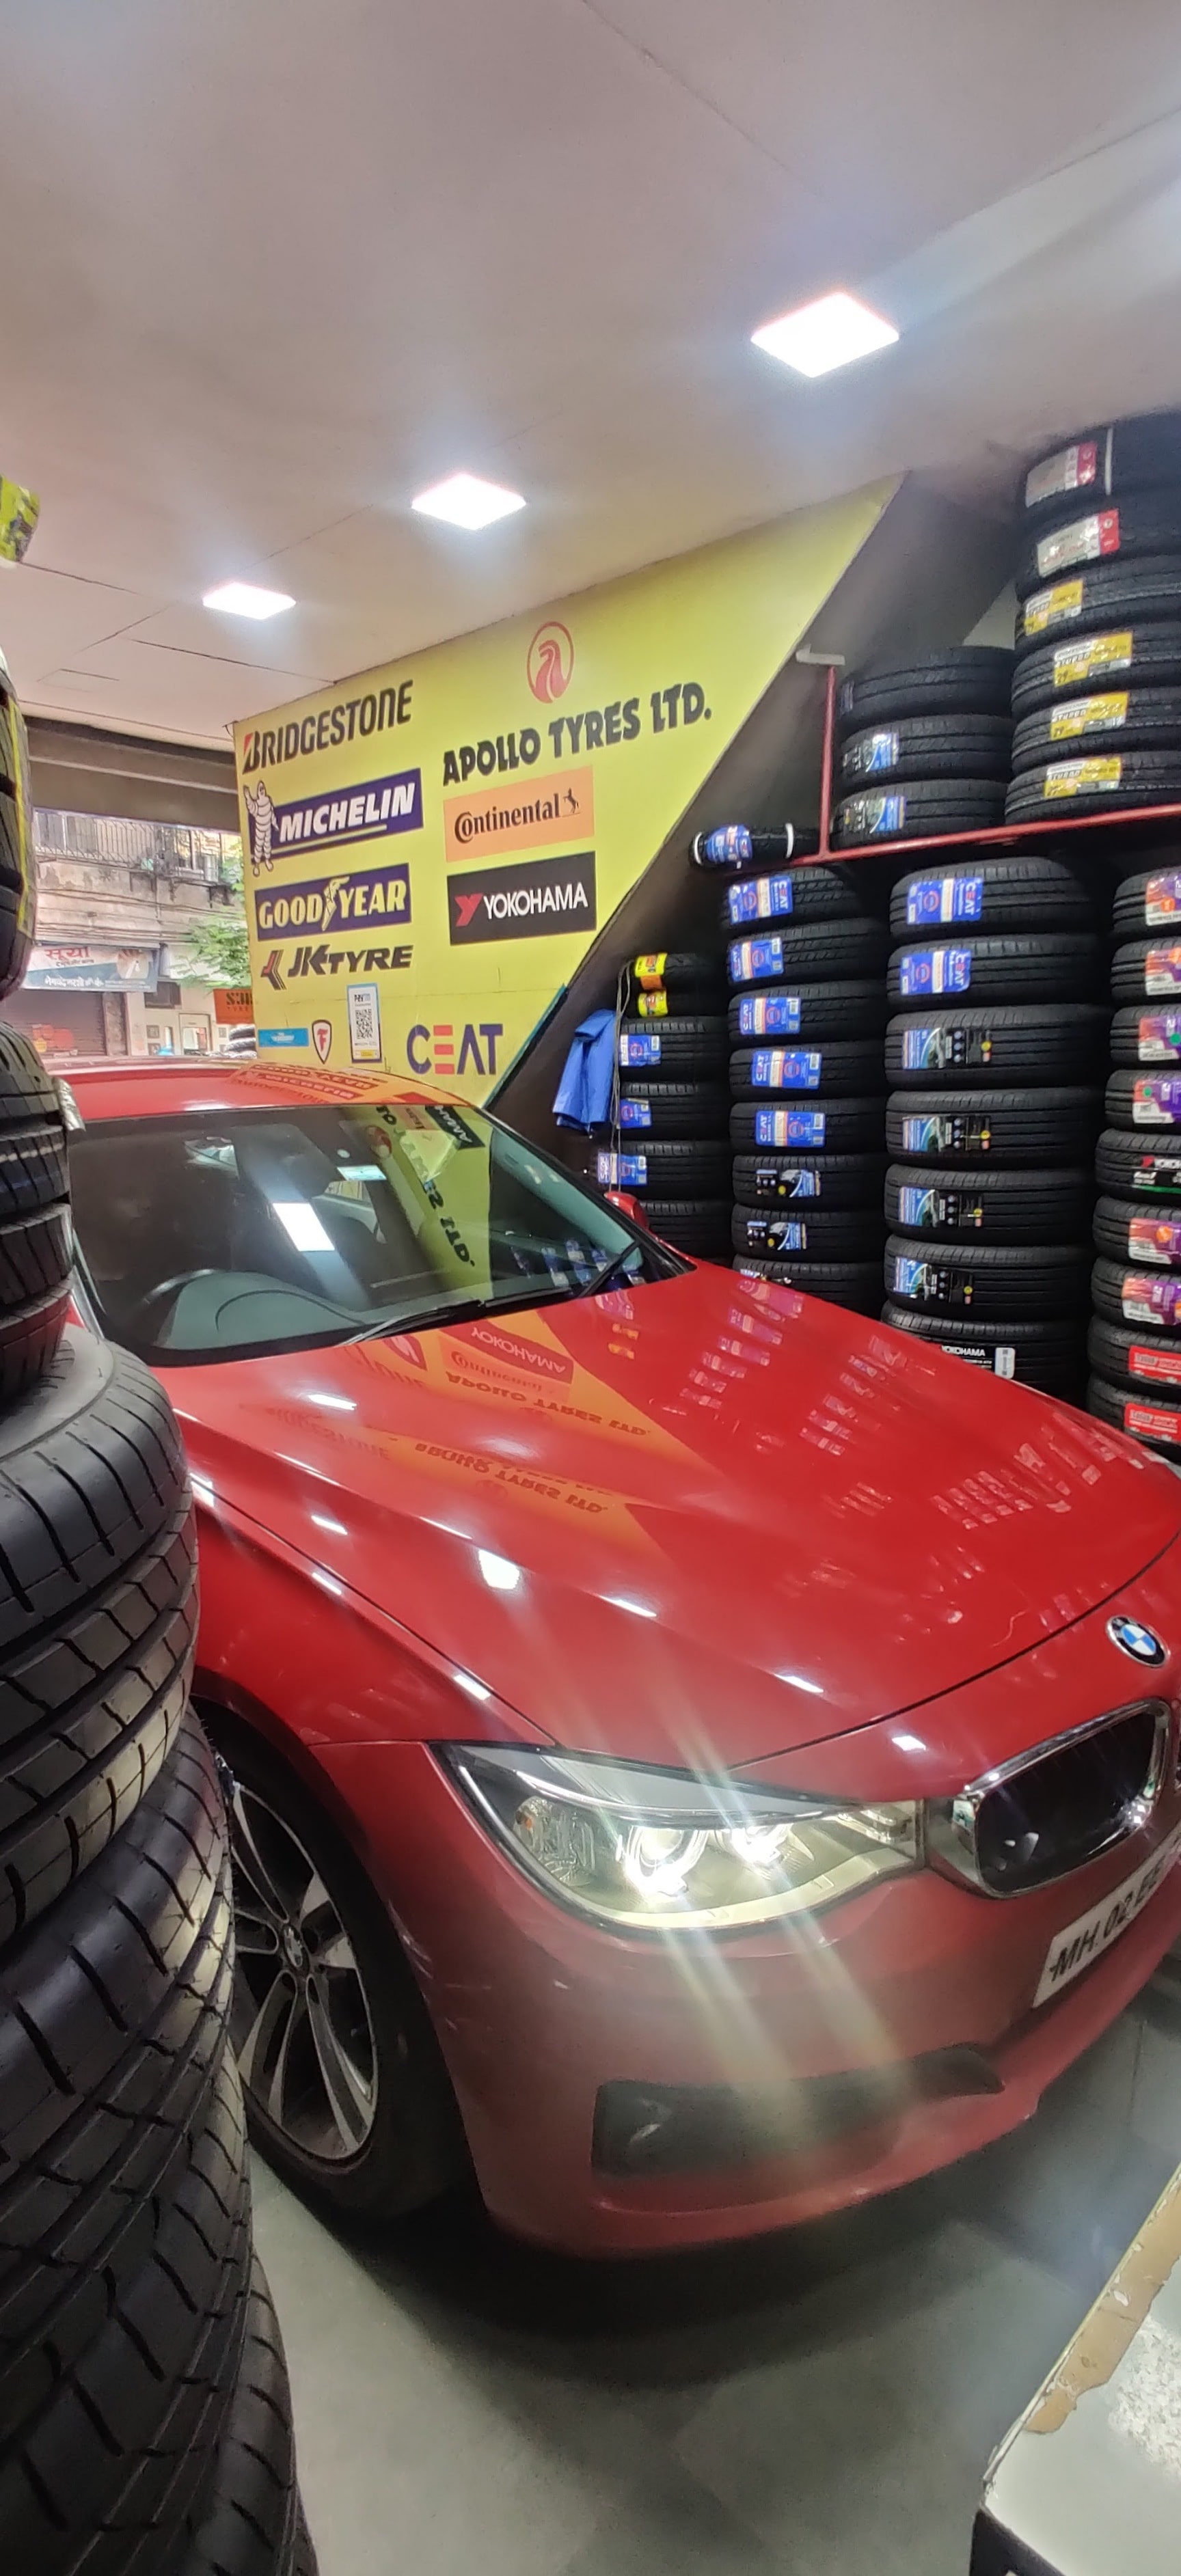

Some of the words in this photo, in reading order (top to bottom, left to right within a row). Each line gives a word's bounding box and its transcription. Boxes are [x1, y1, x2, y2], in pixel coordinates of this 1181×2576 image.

[243, 680, 413, 774] BRIDGESTONE
[442, 728, 542, 786] APOLLO
[549, 697, 640, 759] TYRES
[650, 682, 713, 735] LTD.
[280, 781, 416, 842] MICHELIN
[454, 797, 561, 844] Continental
[258, 877, 408, 929] GOODYEAR
[483, 882, 588, 920] YOKOHAMA
[965, 882, 976, 915] CEAT
[407, 1024, 503, 1075] CEAT
